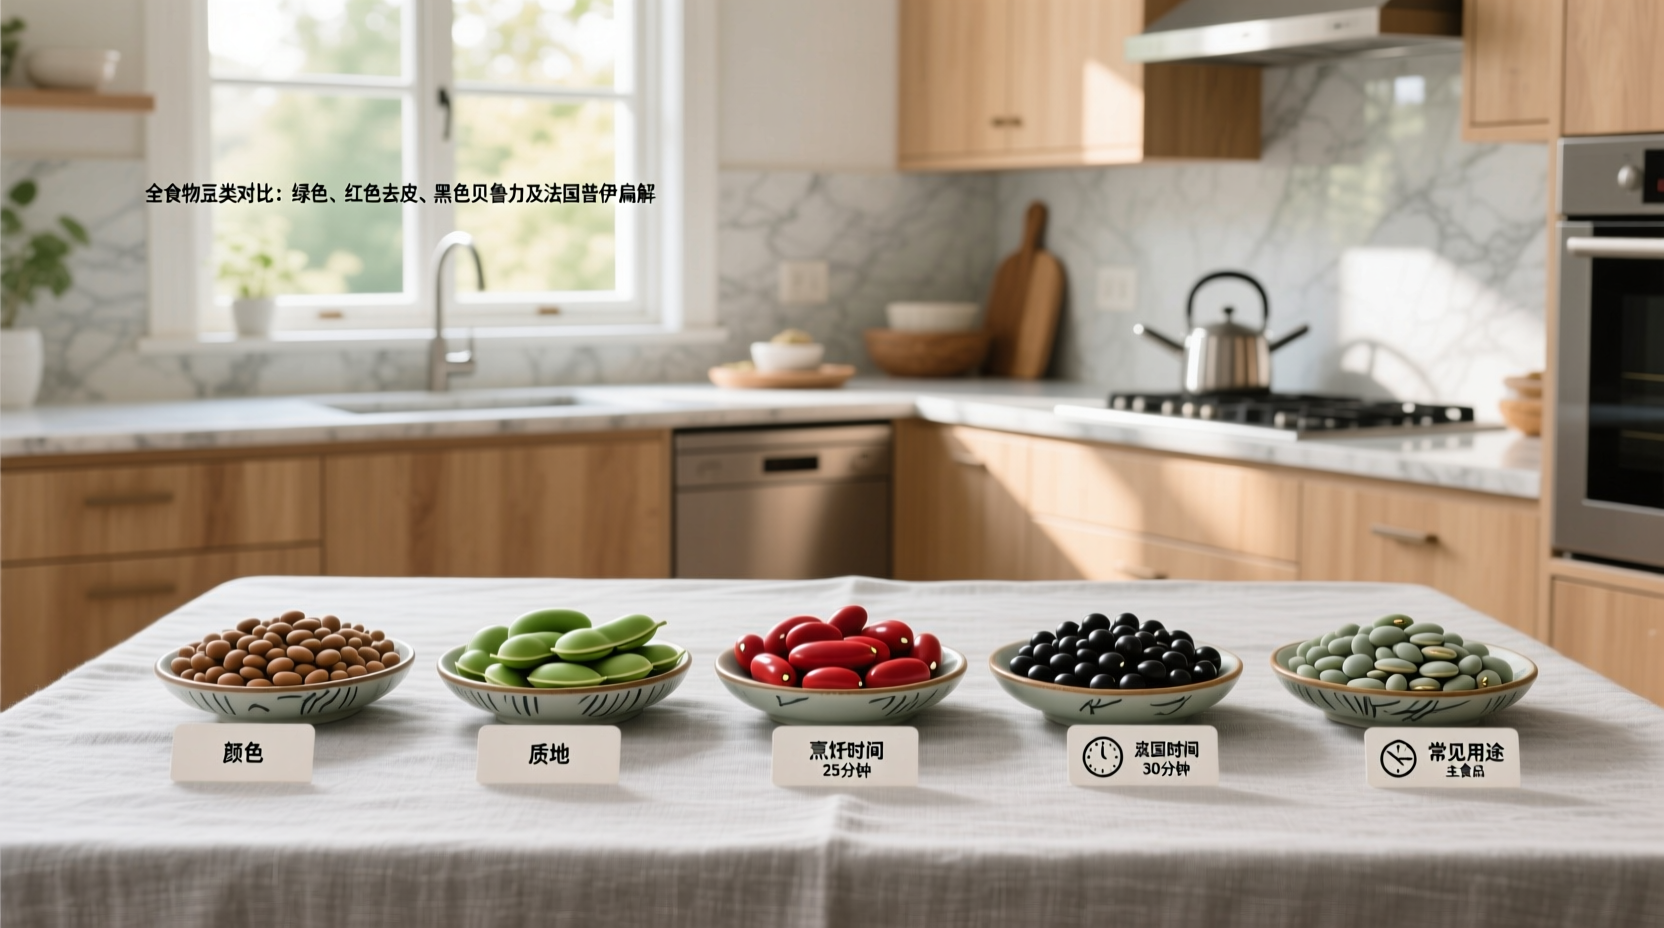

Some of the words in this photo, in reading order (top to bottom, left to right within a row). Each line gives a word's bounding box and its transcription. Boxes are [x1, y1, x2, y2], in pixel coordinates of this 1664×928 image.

[222, 741, 264, 764] 颜色
[528, 742, 570, 765] 质地
[1428, 741, 1505, 762] 常见用途
[822, 762, 872, 779] 25分钟
[1142, 760, 1191, 777] 30分钟
